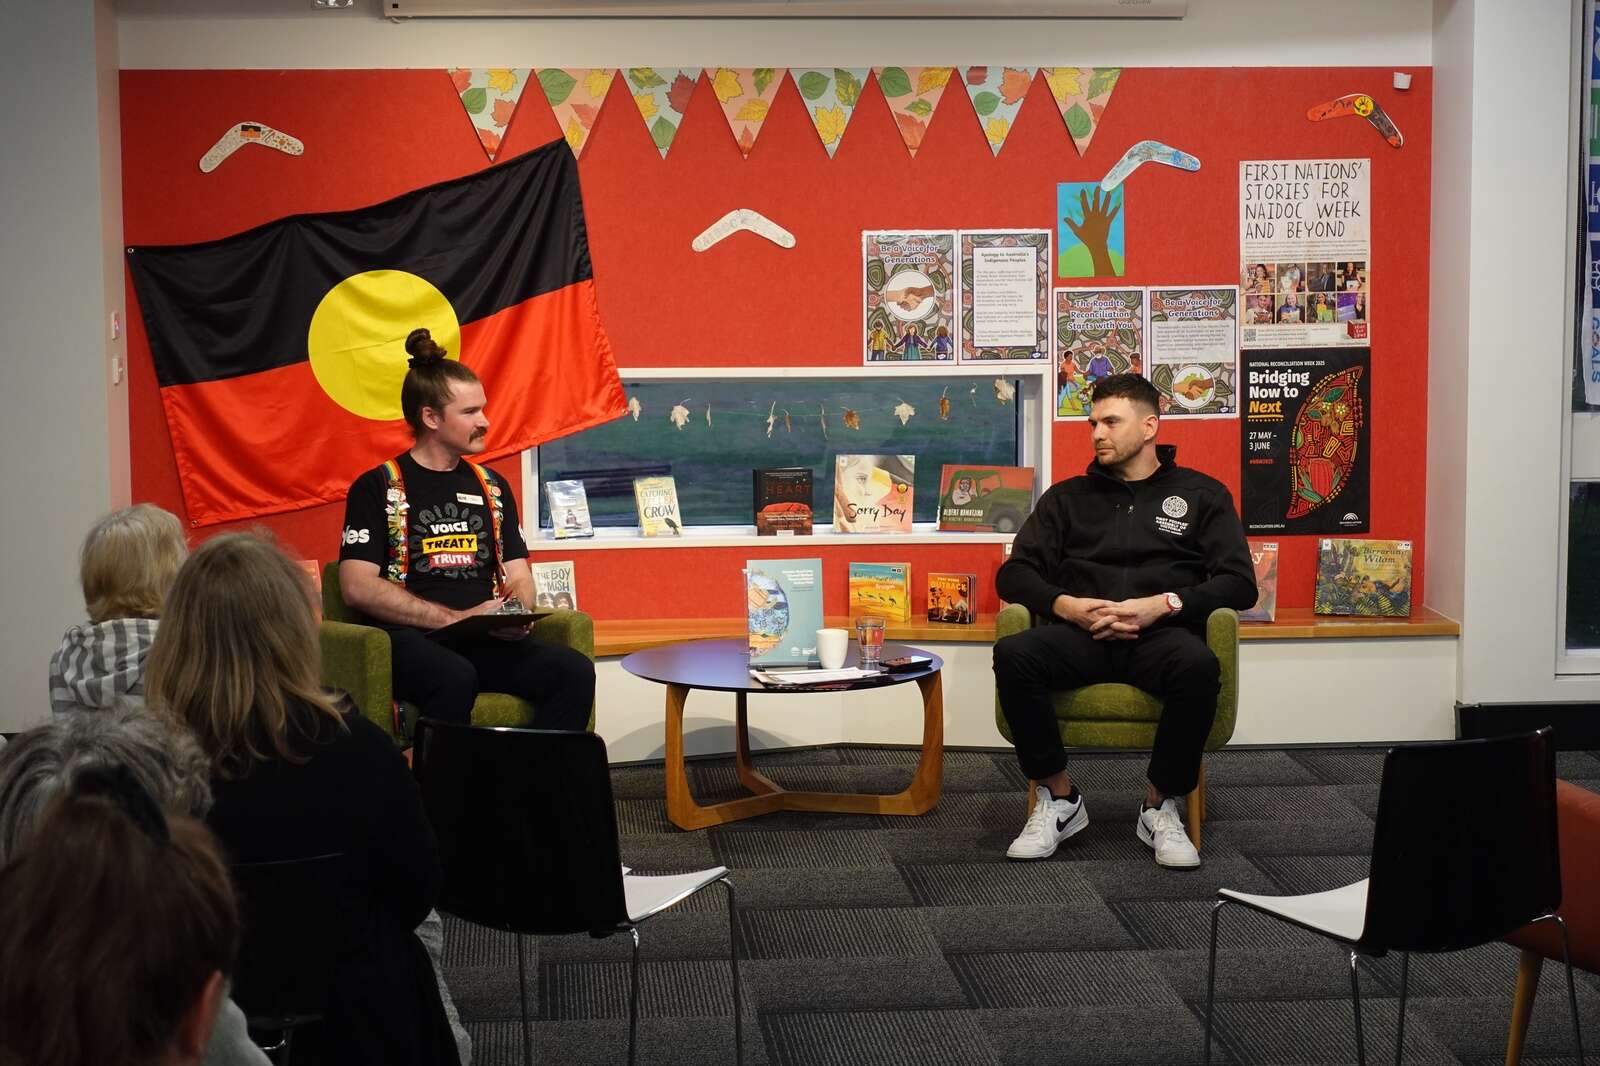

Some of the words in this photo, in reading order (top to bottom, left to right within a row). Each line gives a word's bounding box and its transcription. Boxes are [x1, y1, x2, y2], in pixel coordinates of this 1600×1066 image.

[1245, 163, 1289, 181] FIRST
[1295, 162, 1362, 181] NATIONS'
[1245, 182, 1310, 201] STORIES
[1321, 182, 1350, 199] FOR
[1245, 202, 1303, 220] NAIDOC
[1316, 200, 1361, 219] WEEK
[1245, 222, 1275, 239] AND
[1287, 221, 1346, 239] BEYOND
[901, 244, 924, 252] Voice
[925, 244, 938, 254] for
[884, 256, 936, 264] Generations
[1208, 298, 1221, 308] for
[1071, 310, 1130, 319] Reconciliation
[1168, 309, 1217, 318] Generations
[1068, 322, 1094, 330] Starts
[1096, 321, 1115, 329] with
[1118, 321, 1133, 329] You
[1249, 369, 1310, 387] Bridging
[1249, 387, 1281, 399] Now
[1284, 386, 1299, 398] to
[1249, 401, 1282, 413] Next
[1249, 432, 1257, 440] 27
[1258, 432, 1272, 440] MAY
[1249, 442, 1254, 450] 3
[1254, 442, 1271, 450] JUNE
[643, 504, 676, 519] CROW
[847, 503, 880, 522] Sorry
[882, 504, 906, 522] Day
[430, 521, 469, 534] VOICE
[426, 538, 474, 550] TREATY
[432, 553, 473, 565] TRUTH
[1364, 554, 1396, 563] Wilam
[551, 567, 571, 580] BOY
